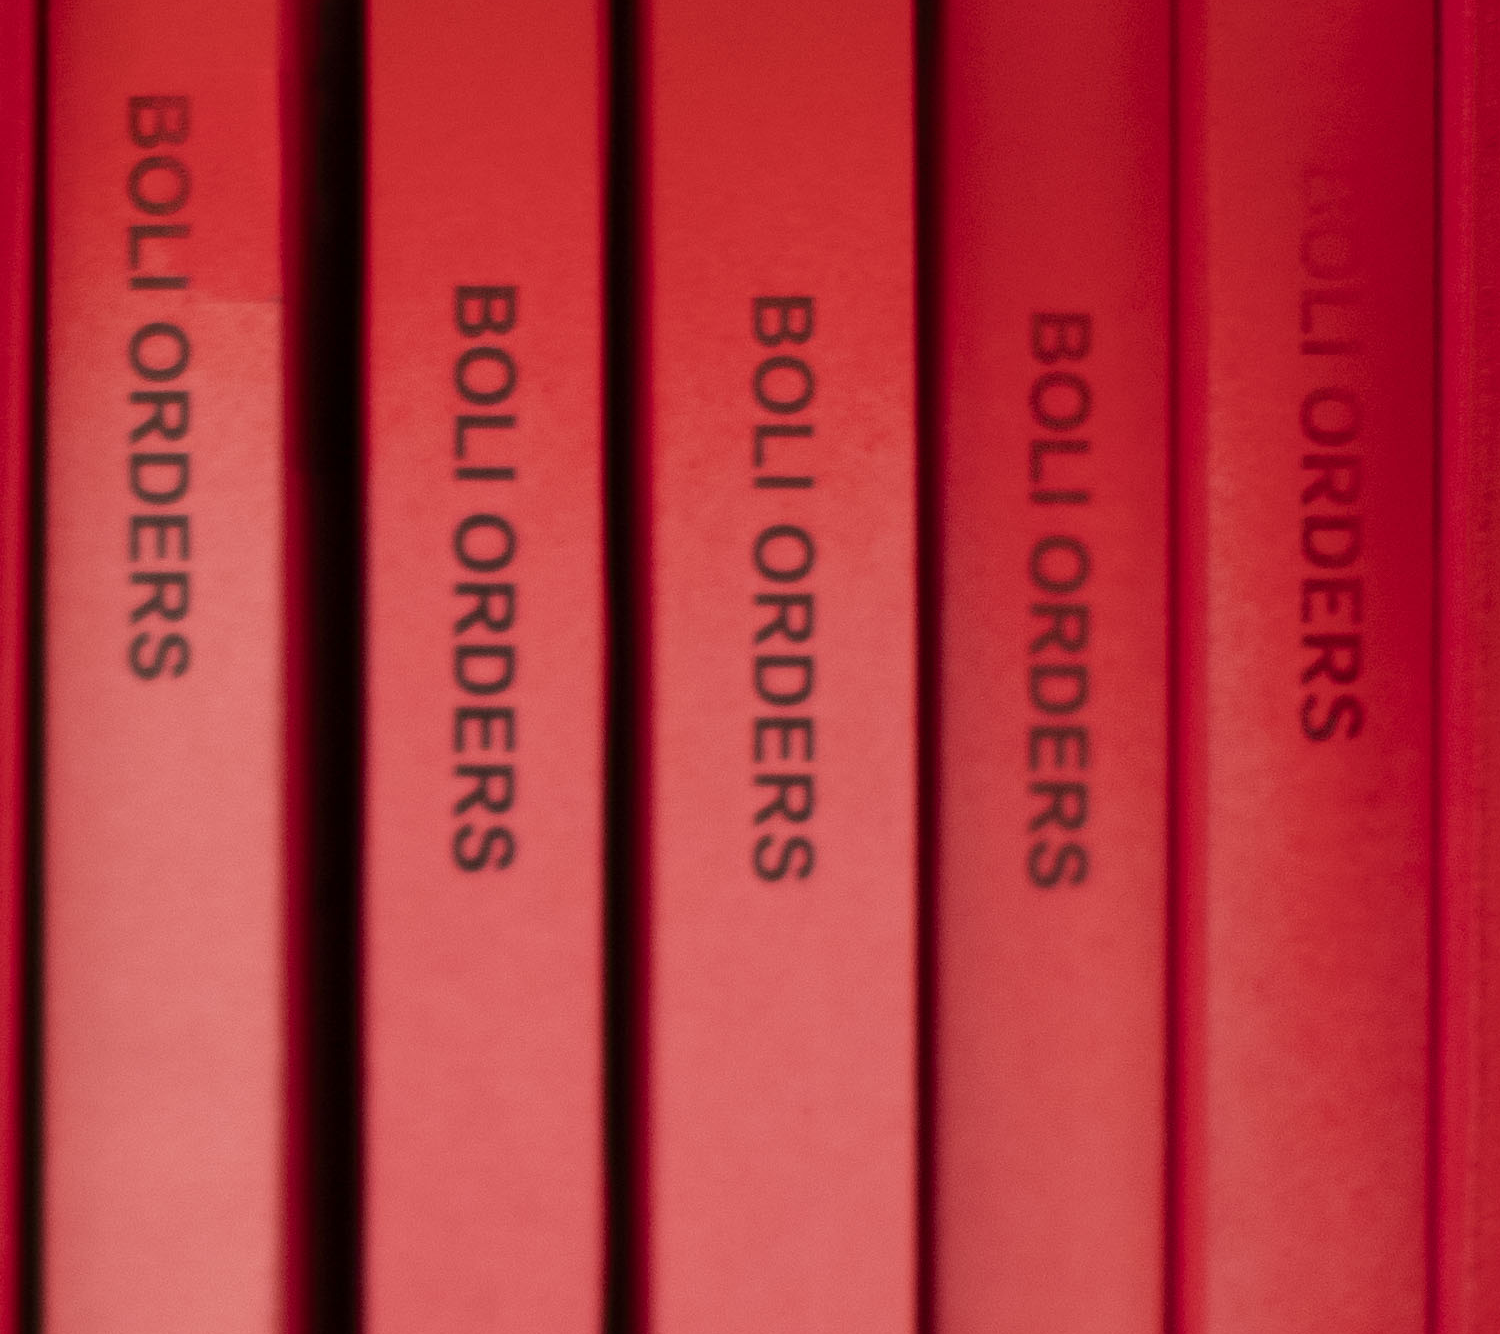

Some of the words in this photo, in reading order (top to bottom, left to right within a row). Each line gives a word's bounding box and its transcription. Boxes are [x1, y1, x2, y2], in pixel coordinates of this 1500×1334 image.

[126, 93, 192, 292] BOLI
[126, 321, 192, 681] ORDERS
[453, 284, 519, 481] BOLI
[752, 296, 816, 489] BOLI
[1029, 311, 1093, 504] BOLI
[451, 514, 517, 873] ORDERS
[752, 524, 817, 883] ORDERS
[1026, 534, 1092, 889] ORDERS
[1298, 387, 1367, 744] ORDERS
